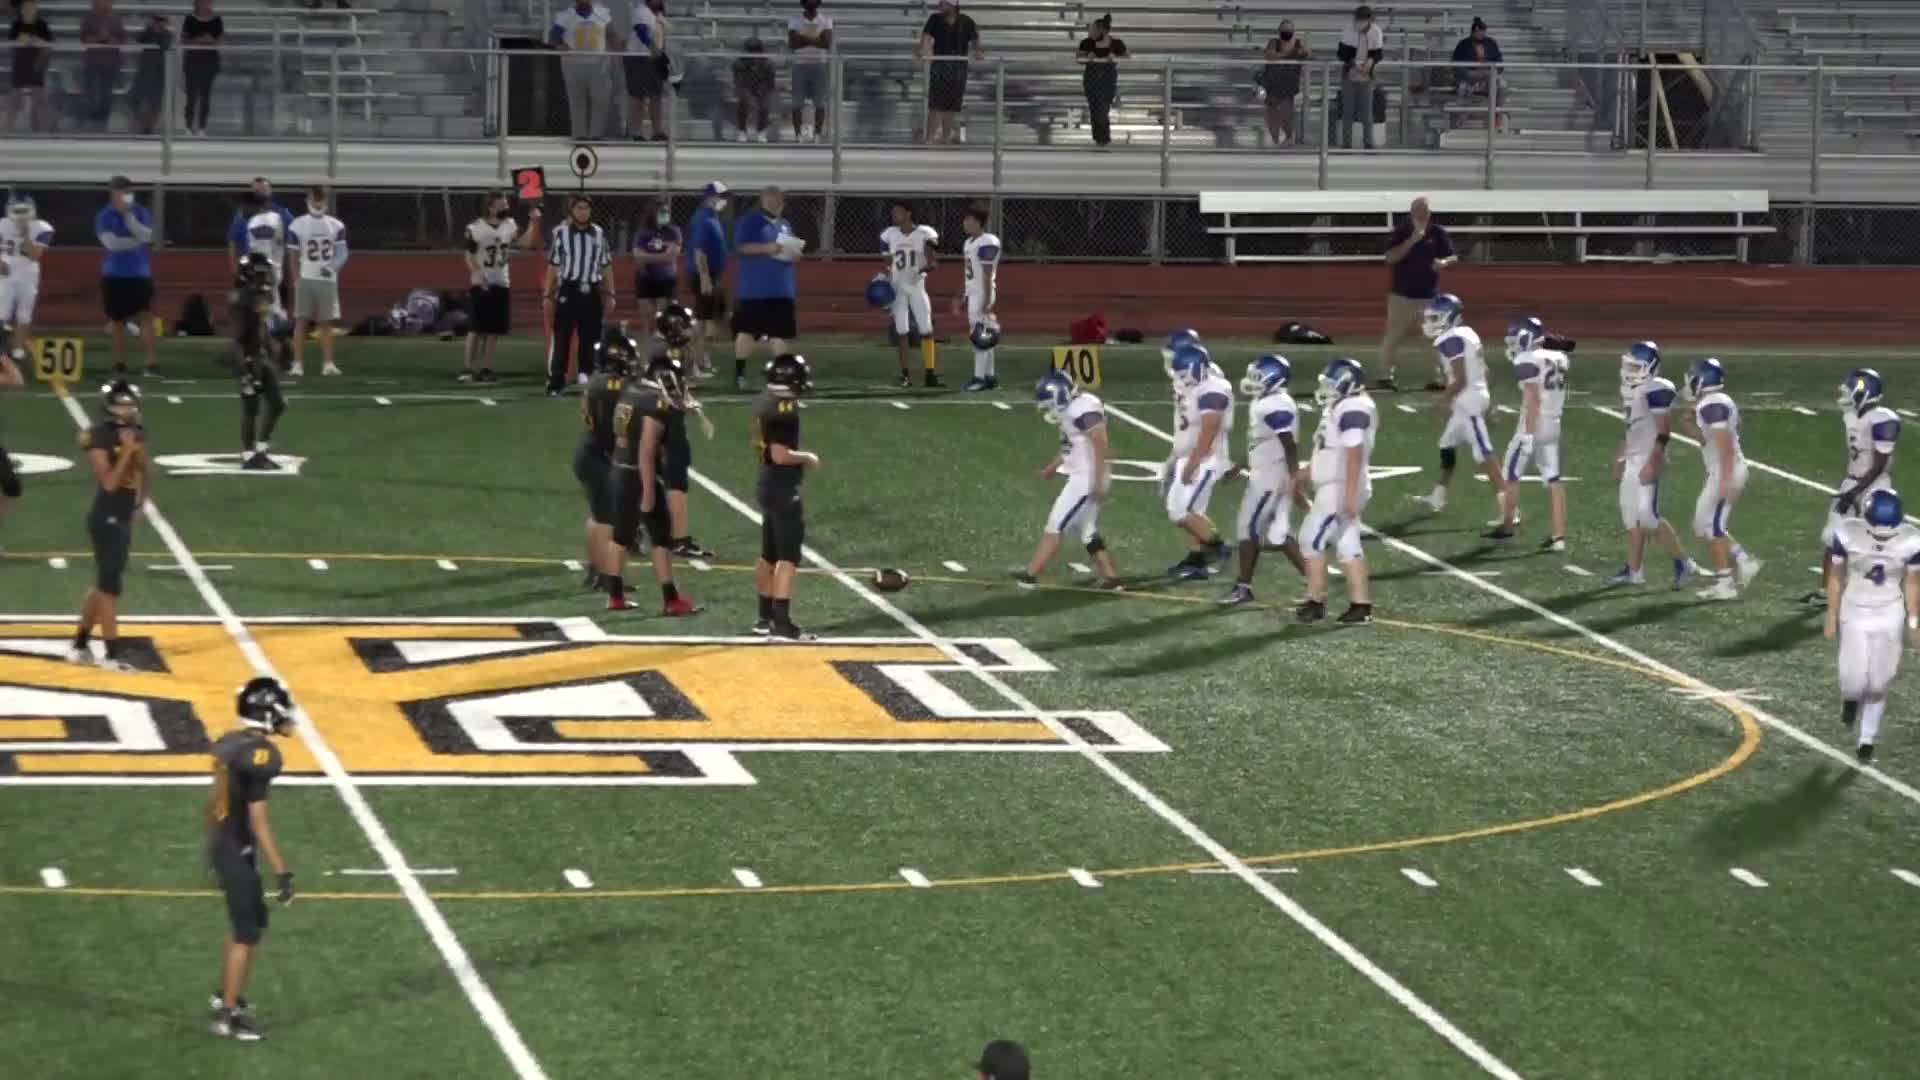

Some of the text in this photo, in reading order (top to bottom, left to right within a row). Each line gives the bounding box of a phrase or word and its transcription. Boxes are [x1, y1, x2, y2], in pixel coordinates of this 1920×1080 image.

[517, 170, 543, 199] 2
[307, 239, 335, 262] 22
[895, 249, 916, 270] 31
[40, 341, 78, 376] 50
[1864, 563, 1887, 586] 4
